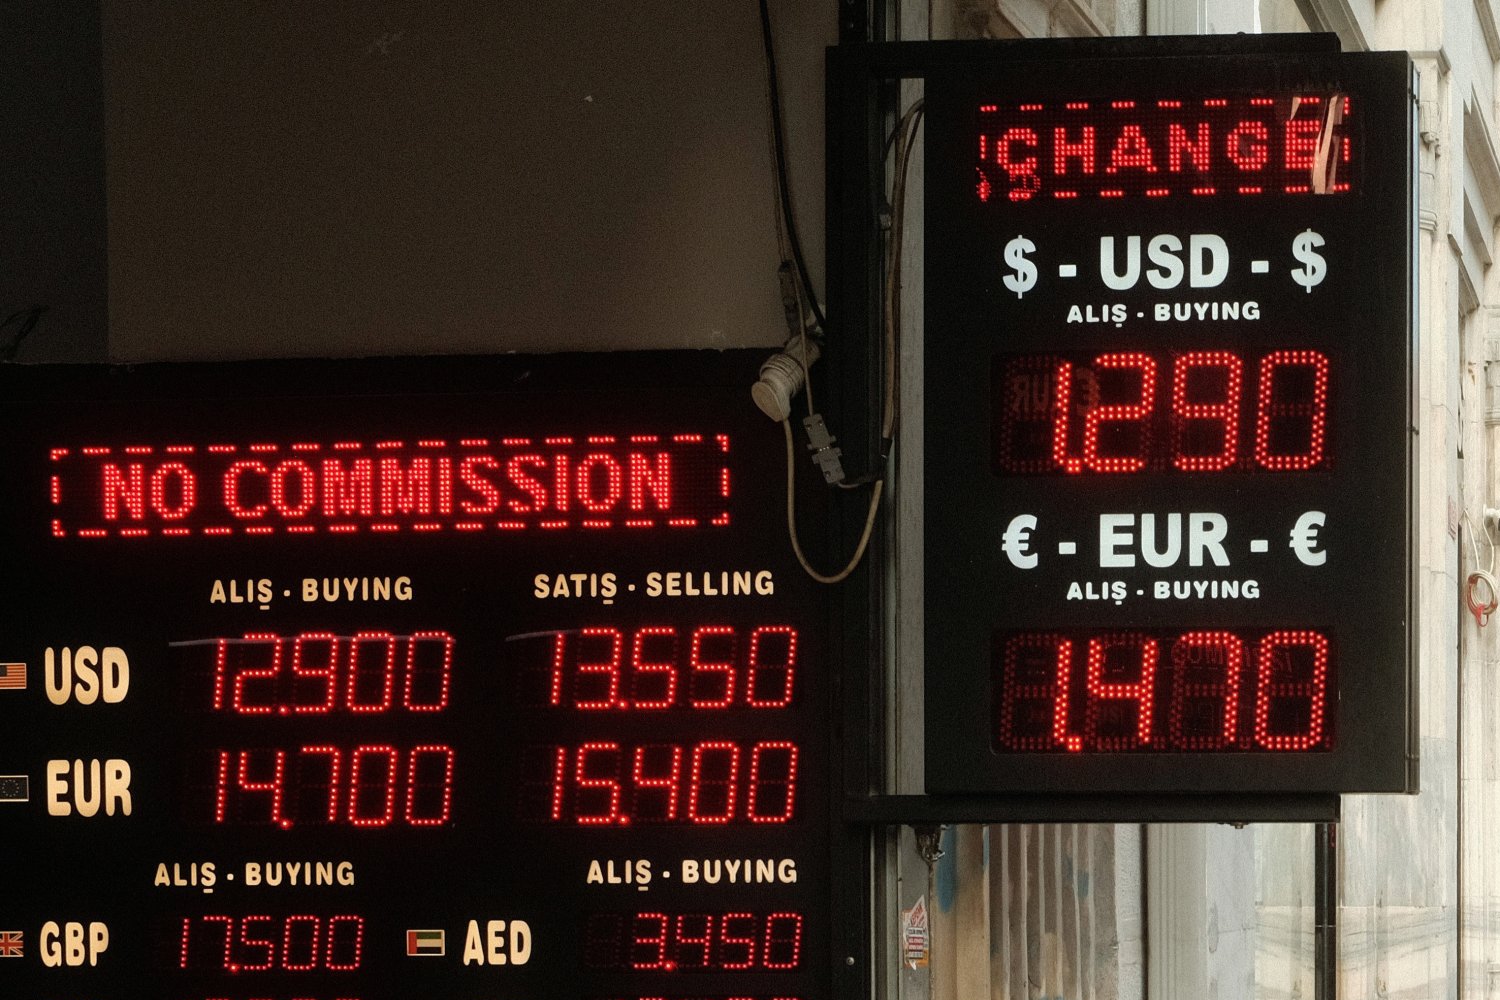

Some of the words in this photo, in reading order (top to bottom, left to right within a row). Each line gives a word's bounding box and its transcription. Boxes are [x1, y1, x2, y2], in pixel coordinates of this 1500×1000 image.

[996, 119, 1322, 176] CHANGE
[1002, 234, 1038, 300] $
[1099, 233, 1230, 291] USD
[1290, 228, 1328, 294] $
[1066, 303, 1128, 328] ALIŞ
[1154, 300, 1261, 322] BUYING
[102, 459, 196, 521] NO
[224, 452, 673, 519] COMMISSION
[1001, 513, 1039, 570] €
[1099, 512, 1231, 569] EUR
[1288, 510, 1327, 567] €
[210, 578, 273, 610] ALIŞ
[302, 576, 413, 602] BUYING
[534, 572, 618, 605] SATIŞ
[646, 570, 775, 598] SELLING
[1066, 580, 1128, 606] ALIŞ
[1153, 579, 1260, 600] BUYING
[44, 645, 130, 706] USD
[214, 631, 453, 714] 12.900
[552, 626, 798, 710] 13.550
[46, 758, 132, 818] EUR
[216, 745, 454, 829] 14.700
[552, 741, 799, 825] 15.400
[154, 862, 217, 894] ALIŞ
[245, 861, 355, 887] BUYING
[586, 859, 652, 891] ALIŞ
[682, 858, 798, 885] BUYING
[40, 921, 109, 967] GBP
[180, 915, 364, 972] 17.500
[463, 920, 531, 965] AED
[634, 913, 802, 971] 3.450
